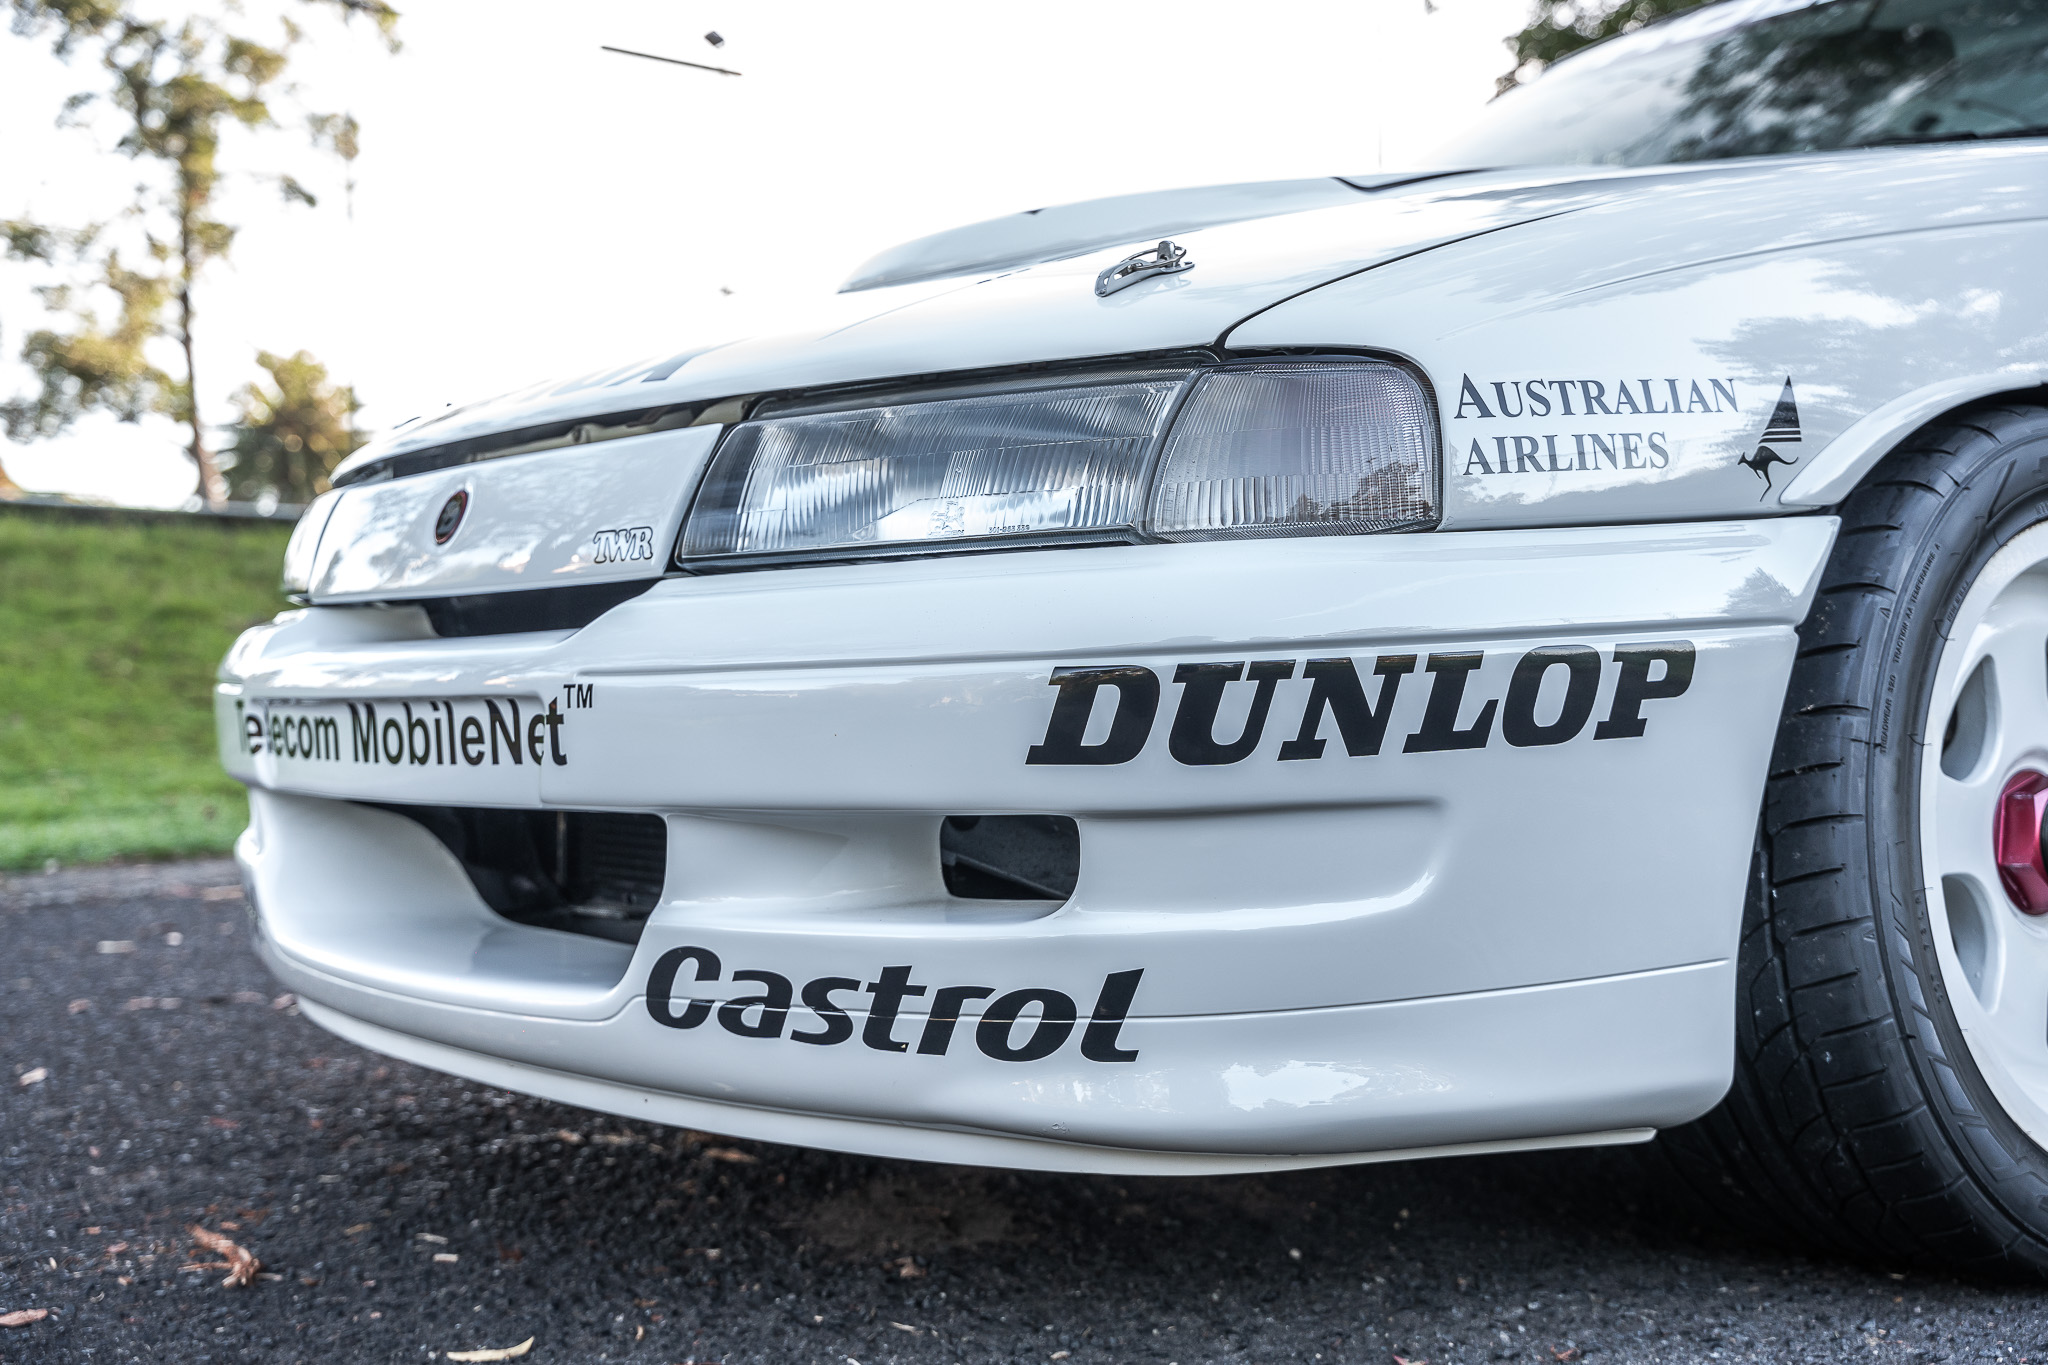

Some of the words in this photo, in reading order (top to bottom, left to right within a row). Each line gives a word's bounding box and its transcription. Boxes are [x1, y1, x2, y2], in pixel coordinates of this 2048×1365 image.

[1453, 373, 1740, 420] AUSTRALIAN
[1463, 431, 1670, 476] AIRLINES
[593, 526, 653, 564] TWR
[1880, 698, 1893, 755] TREADWEAR
[1893, 621, 1909, 664] TRACTION
[1910, 551, 1936, 604] TEMPERATURE
[235, 699, 341, 761] Telecom
[346, 697, 568, 766] MobileNet
[1025, 640, 1697, 766] DUNLOP
[645, 946, 1145, 1062] Castrol
